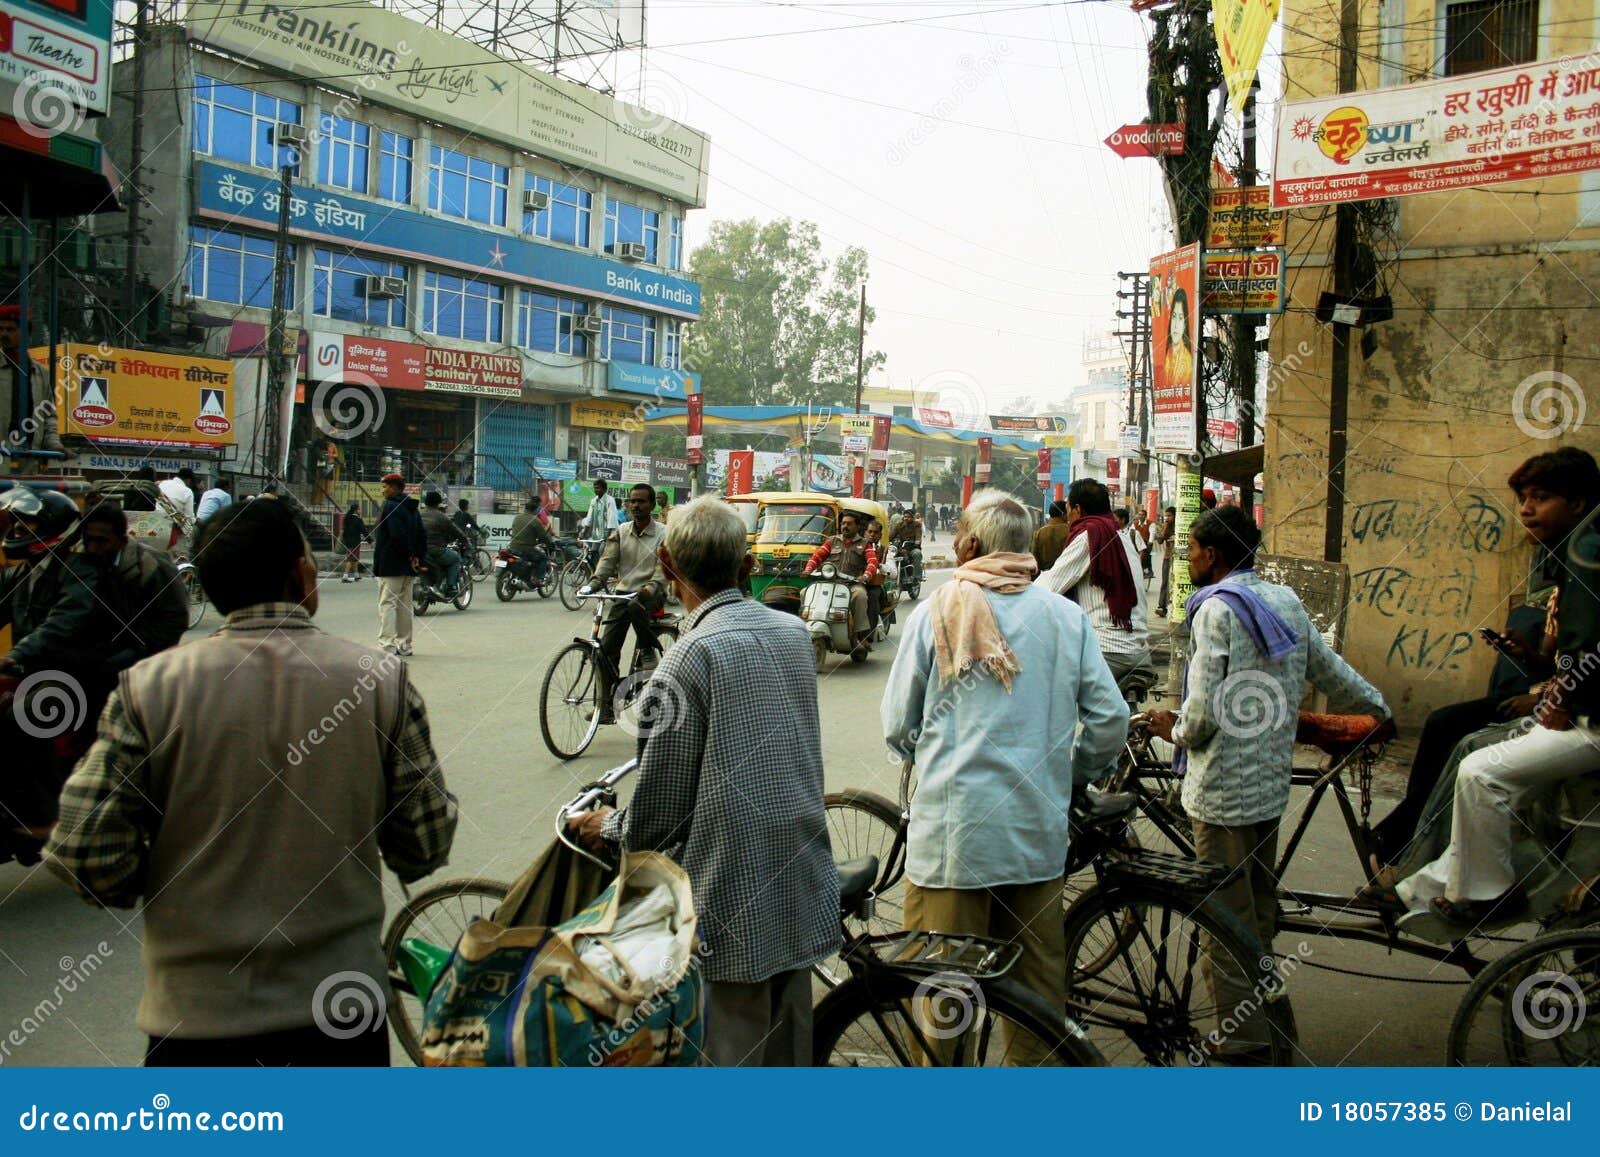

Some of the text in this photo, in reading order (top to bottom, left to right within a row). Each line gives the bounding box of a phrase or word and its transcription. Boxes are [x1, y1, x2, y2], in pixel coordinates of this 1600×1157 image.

[28, 35, 84, 69] Theatre
[232, 17, 278, 40] INSTITUTE
[297, 42, 312, 55] AIR
[315, 47, 350, 67] HOSTESS
[23, 66, 47, 84] YOU
[52, 79, 64, 90] IN
[399, 56, 478, 103] fly high
[1444, 92, 1471, 117] हर
[1476, 74, 1533, 117] खुशी
[1539, 70, 1560, 100] में
[1297, 121, 1309, 136] श्री
[1545, 110, 1558, 125] के
[1124, 129, 1184, 145] vodafone
[1312, 127, 1326, 143] हरे
[661, 136, 679, 152] 2222
[680, 143, 693, 158] 777
[1365, 140, 1430, 165] ज्वेलर्स
[1329, 174, 1369, 188] वाराणसी
[217, 173, 256, 206] बैंक
[313, 197, 367, 232] इंडिया
[606, 270, 693, 306] Bank of India
[120, 356, 180, 381] चैम्पियन
[184, 365, 230, 385] सीमेन्ट
[348, 361, 388, 374] Union Bank
[425, 349, 521, 374] INDIA PAINTS
[425, 365, 519, 386] Sanitary Wares
[90, 455, 125, 467] SAMAJ
[657, 473, 684, 483] Complex
